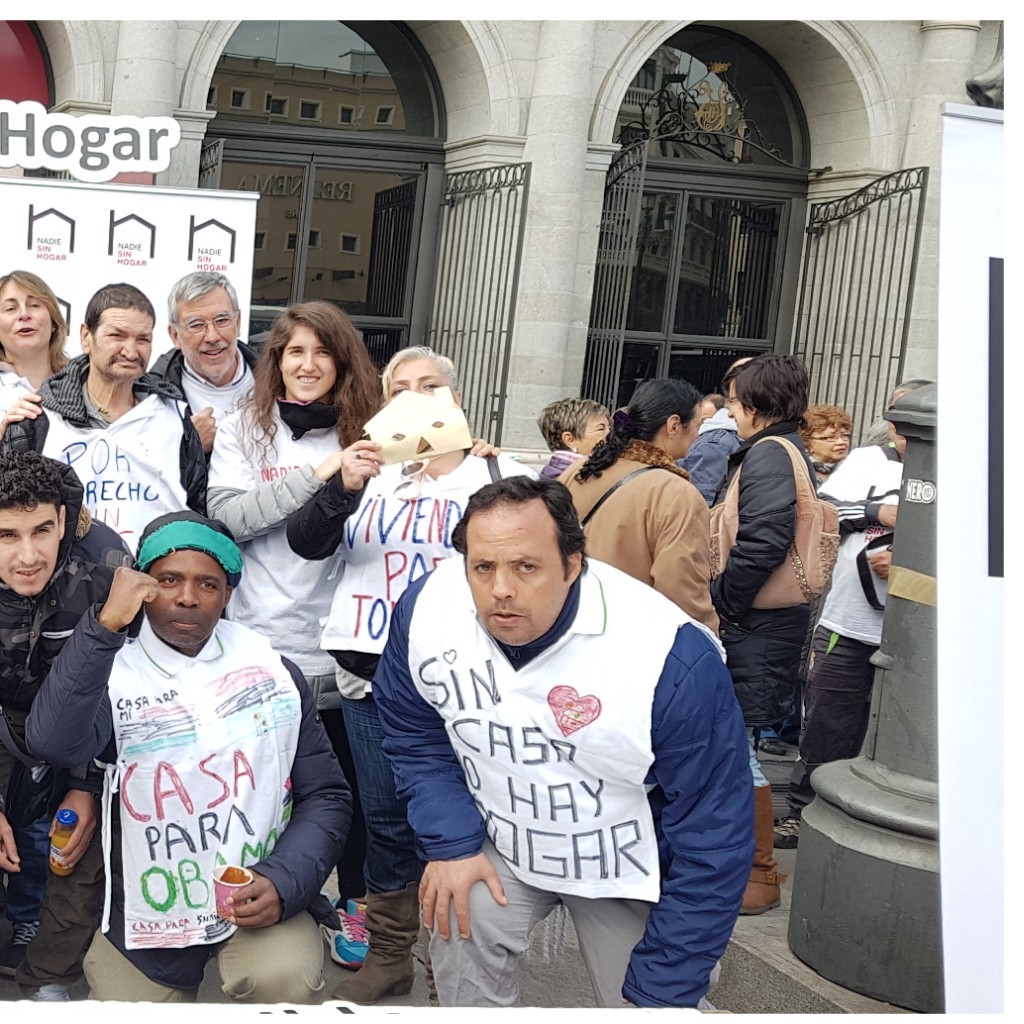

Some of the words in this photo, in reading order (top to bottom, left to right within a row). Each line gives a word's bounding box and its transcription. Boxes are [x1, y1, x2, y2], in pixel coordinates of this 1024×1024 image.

[37, 237, 62, 246] NADIE
[118, 242, 143, 251] NADIE
[37, 245, 51, 253] SIN
[117, 250, 132, 258] SIN
[198, 248, 223, 256] NADIE
[36, 253, 67, 262] HOGAR
[117, 258, 147, 267] HOGAR
[197, 255, 212, 263] SIN
[196, 263, 227, 272] HOGAR
[85, 480, 160, 504] RECHO
[347, 494, 464, 550] VIVIEND
[418, 650, 502, 711] SIN
[117, 696, 150, 710] CASA
[453, 718, 576, 765] CASA
[121, 750, 256, 822] CASA
[507, 777, 605, 823] HAY
[144, 804, 255, 862] PARA
[132, 921, 161, 933] CASA
[166, 918, 190, 929] PARA
